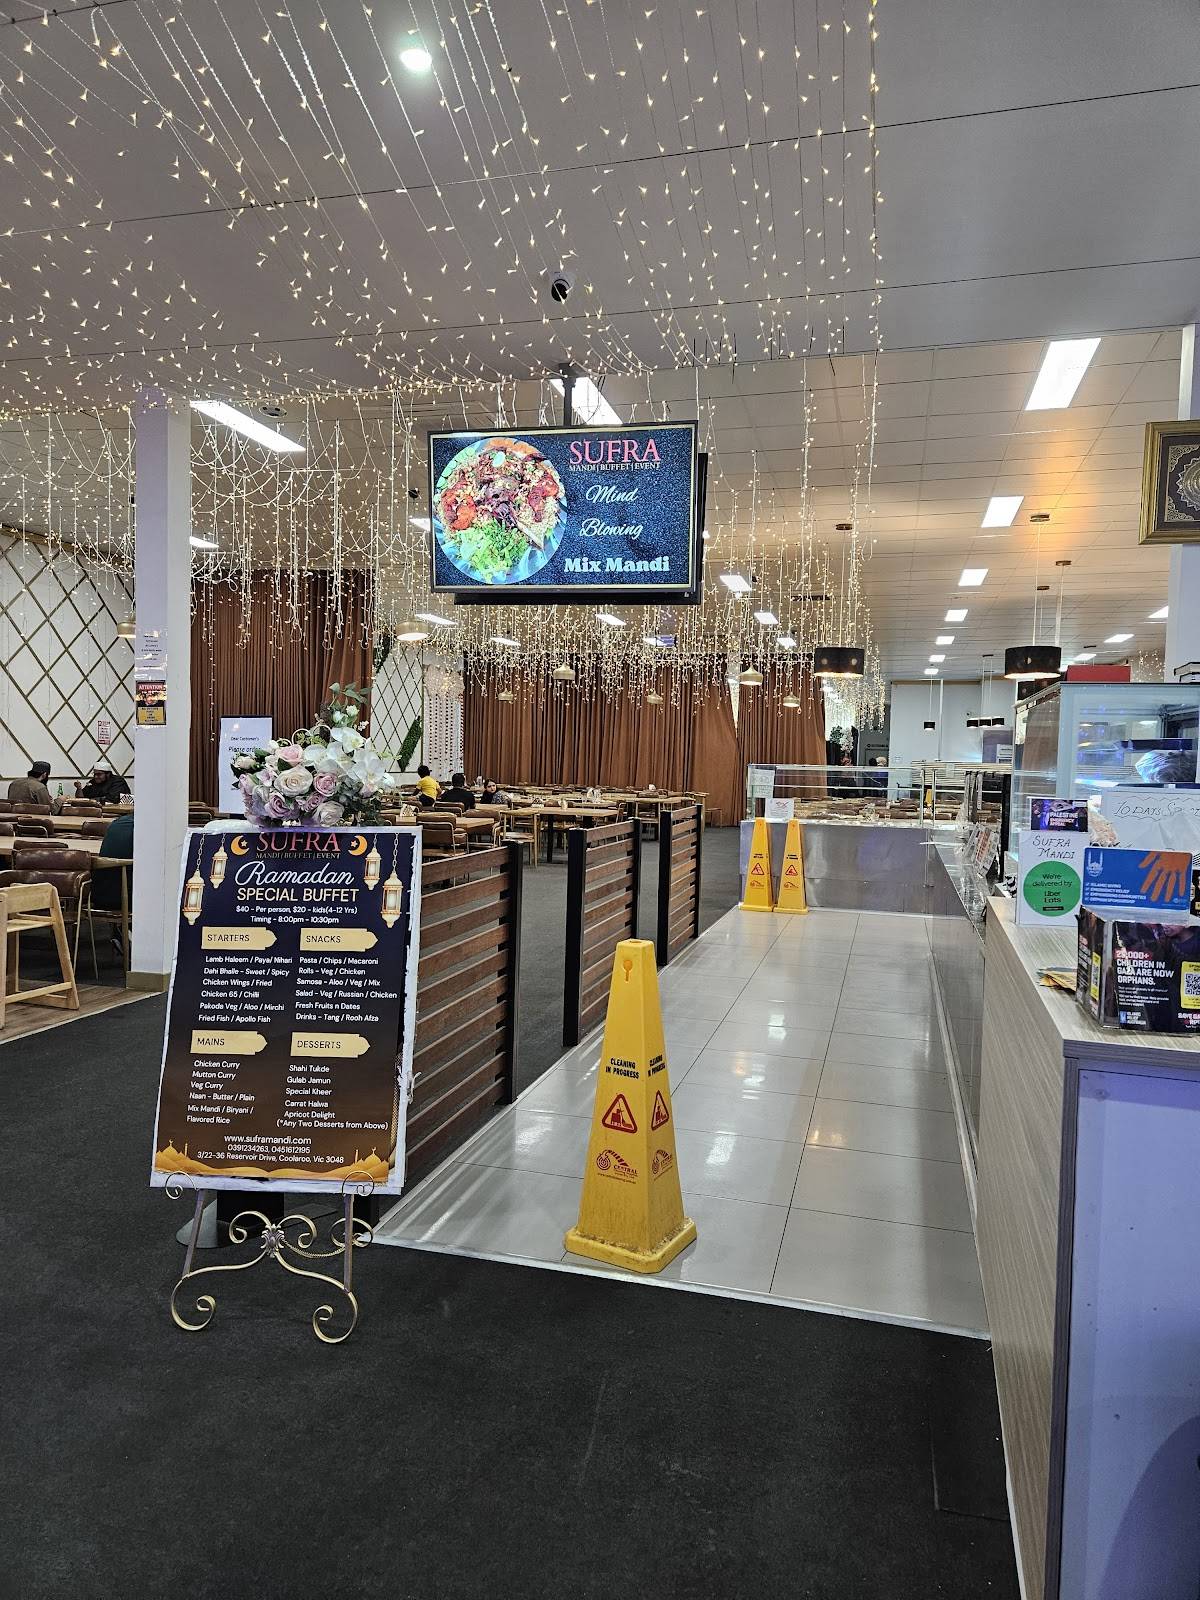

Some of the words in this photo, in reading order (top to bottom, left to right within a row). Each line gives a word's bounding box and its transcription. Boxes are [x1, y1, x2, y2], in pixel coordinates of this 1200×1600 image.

[569, 439, 661, 464] SUFRA
[586, 485, 638, 503] Mind
[580, 518, 643, 539] Blowing
[564, 558, 601, 572] Mix
[605, 556, 670, 572] Mandi
[257, 832, 341, 851] SUFRA
[1033, 836, 1070, 847] SUFRA
[1038, 848, 1075, 859] MANDI
[235, 861, 354, 885] Ramadan
[237, 888, 298, 901] SPECIAL
[303, 888, 359, 902] BUFFET
[236, 905, 249, 913] $40
[344, 907, 358, 915] Yrs)
[251, 916, 271, 924] Timing
[1117, 959, 1154, 968] CHILDREN
[271, 969, 289, 977] Spicy
[321, 968, 333, 976] Veg
[1154, 969, 1174, 978] NOW
[230, 979, 249, 987] Wings
[350, 979, 362, 987] Veg
[1118, 976, 1156, 985] ORPHANS.
[320, 990, 332, 998] Veg
[225, 1003, 238, 1011] Veg
[324, 1014, 340, 1022] Tang
[197, 1038, 224, 1046] MAINS
[222, 1061, 240, 1069] Curry
[611, 1058, 635, 1069] CLEANING
[217, 1072, 236, 1080] Curry
[613, 1068, 639, 1079] PROGRESS
[191, 1081, 203, 1090] Veg
[205, 1082, 223, 1090] Curry
[227, 1106, 248, 1114] Biryani
[187, 1115, 214, 1123] Flavored
[363, 1122, 388, 1130] Above)
[224, 1135, 311, 1144] www.suframandi.com
[259, 1154, 277, 1162] Drive,
[279, 1155, 311, 1163] Coolaroo,
